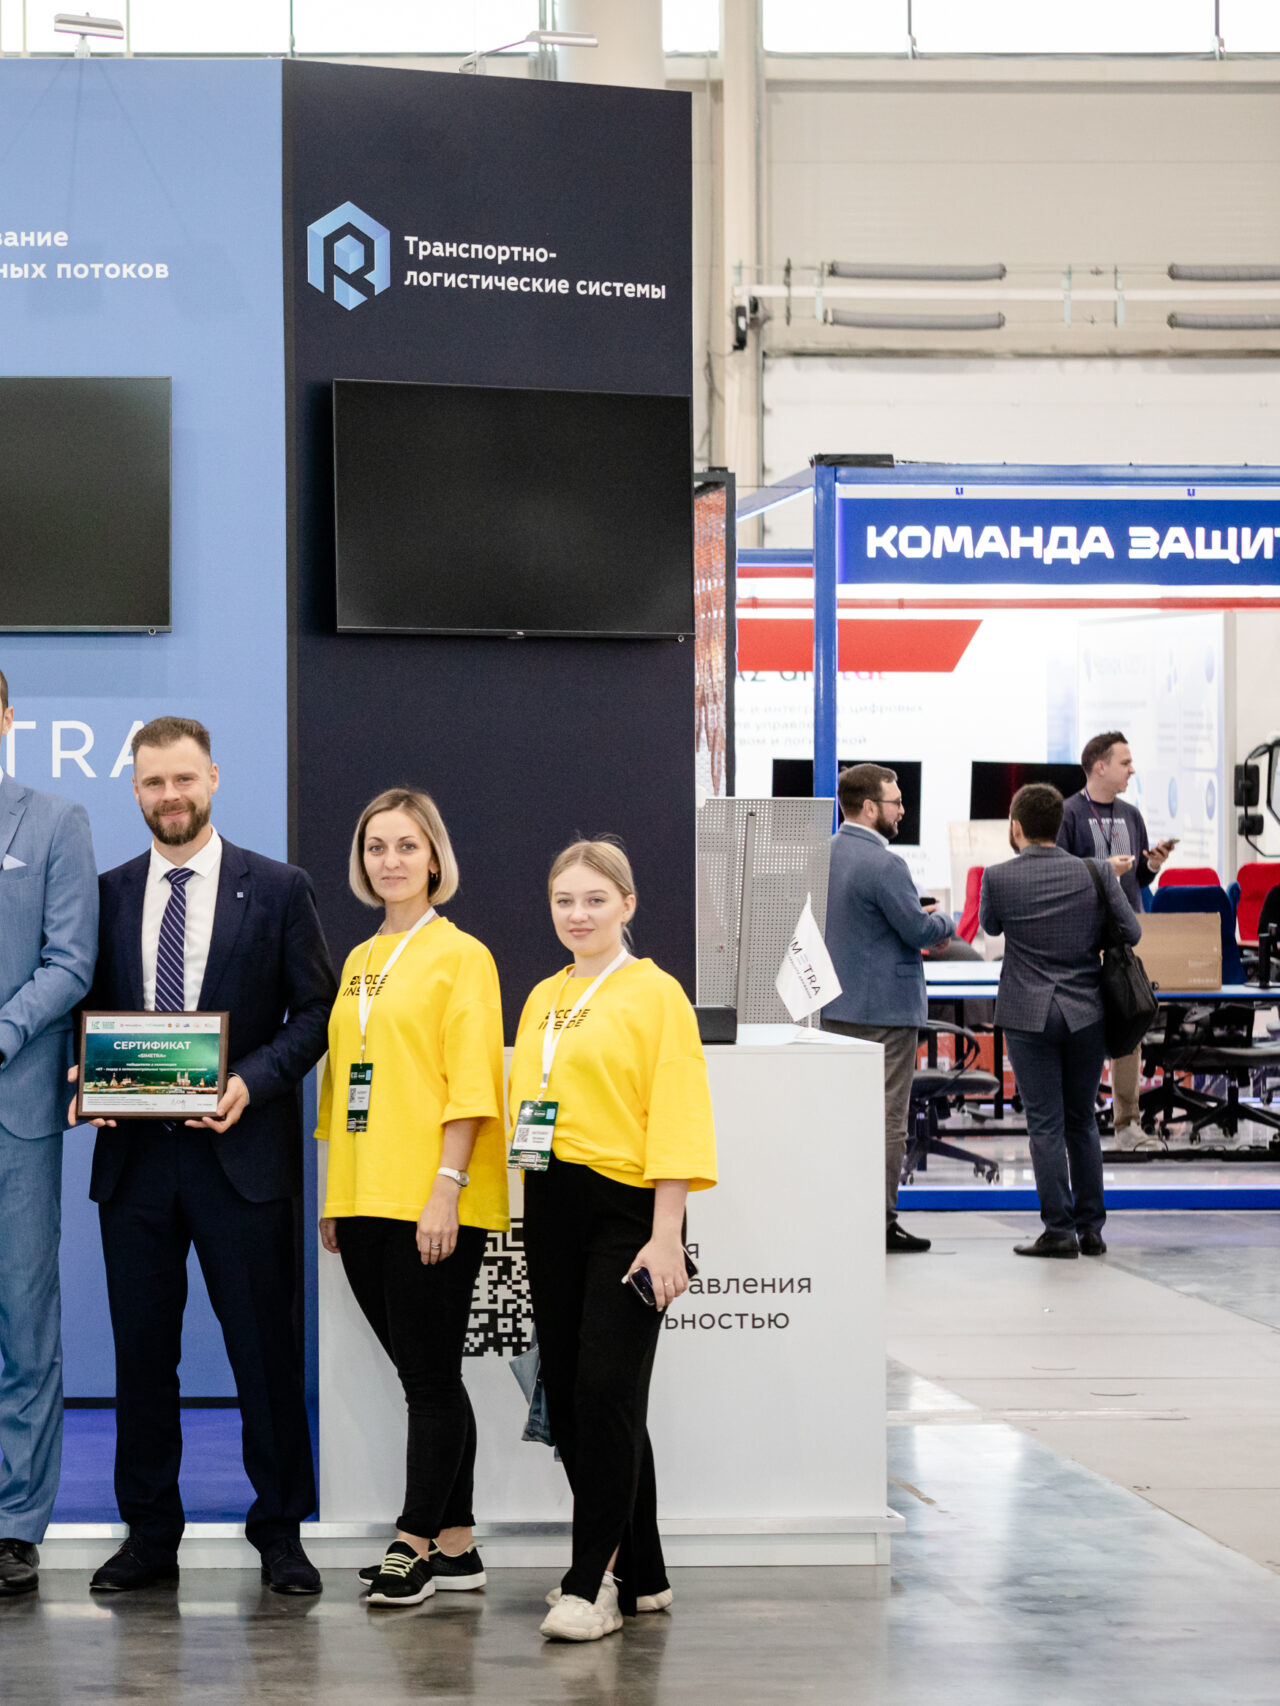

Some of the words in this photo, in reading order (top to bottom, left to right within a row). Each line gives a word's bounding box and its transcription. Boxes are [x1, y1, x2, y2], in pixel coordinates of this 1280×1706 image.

[404, 235, 557, 264] Транспортно-
[56, 262, 169, 279] потоков
[404, 270, 570, 296] логистические
[576, 279, 666, 300] системы
[866, 525, 1115, 565] КОМАНДА
[113, 1040, 192, 1050] СЕРТИФИКАТ
[688, 1276, 812, 1295] авления
[663, 1311, 790, 1330] ьностью
